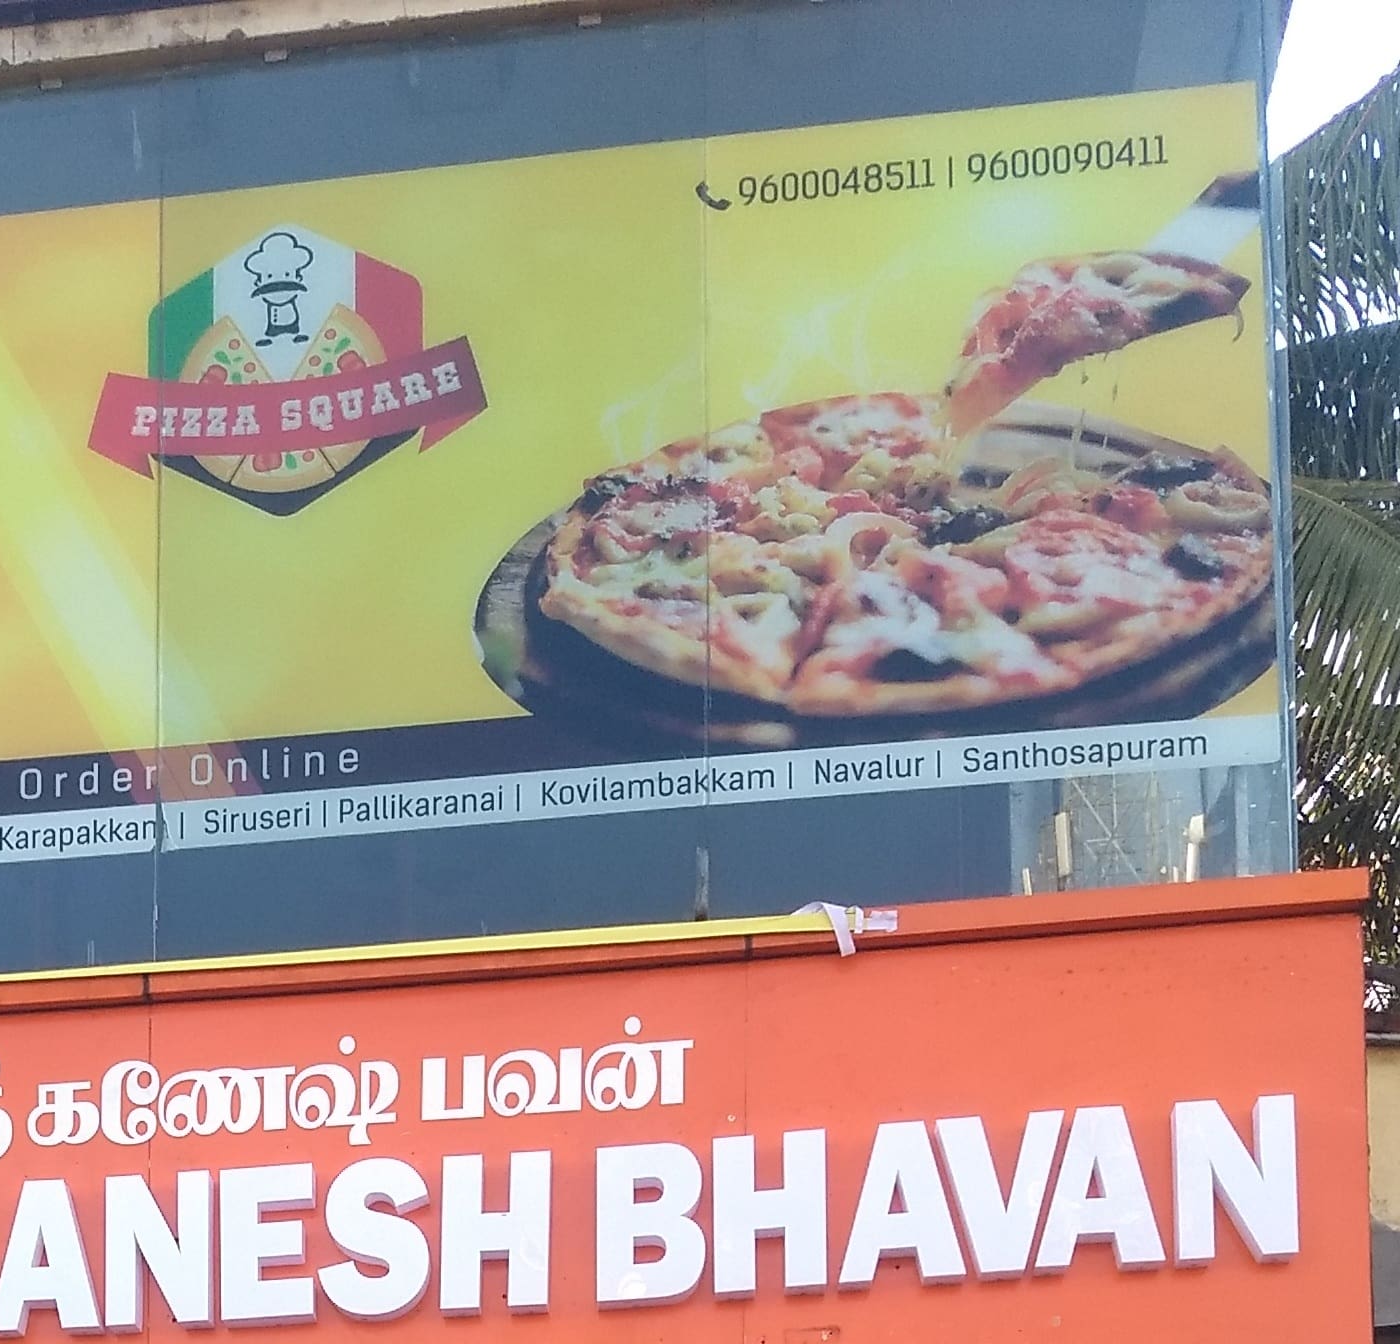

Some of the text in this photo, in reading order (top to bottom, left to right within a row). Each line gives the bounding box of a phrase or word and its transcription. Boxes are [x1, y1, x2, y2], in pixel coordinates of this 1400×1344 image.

[738, 135, 1169, 206] 9600048511 9600090411
[131, 362, 462, 438] PIZZA SQUARE
[20, 761, 157, 801] Order
[190, 744, 360, 786] Online
[204, 801, 310, 835] Siruseri
[339, 785, 503, 824] Pallikaranai
[541, 764, 775, 806] Kovilambakkam
[814, 752, 925, 786] Navalur
[962, 731, 1208, 774] Santhosapuram
[27, 1035, 399, 1147] கணேஷ்
[421, 1016, 695, 1121] பவன்
[595, 1093, 1301, 1312] BHAVAN
